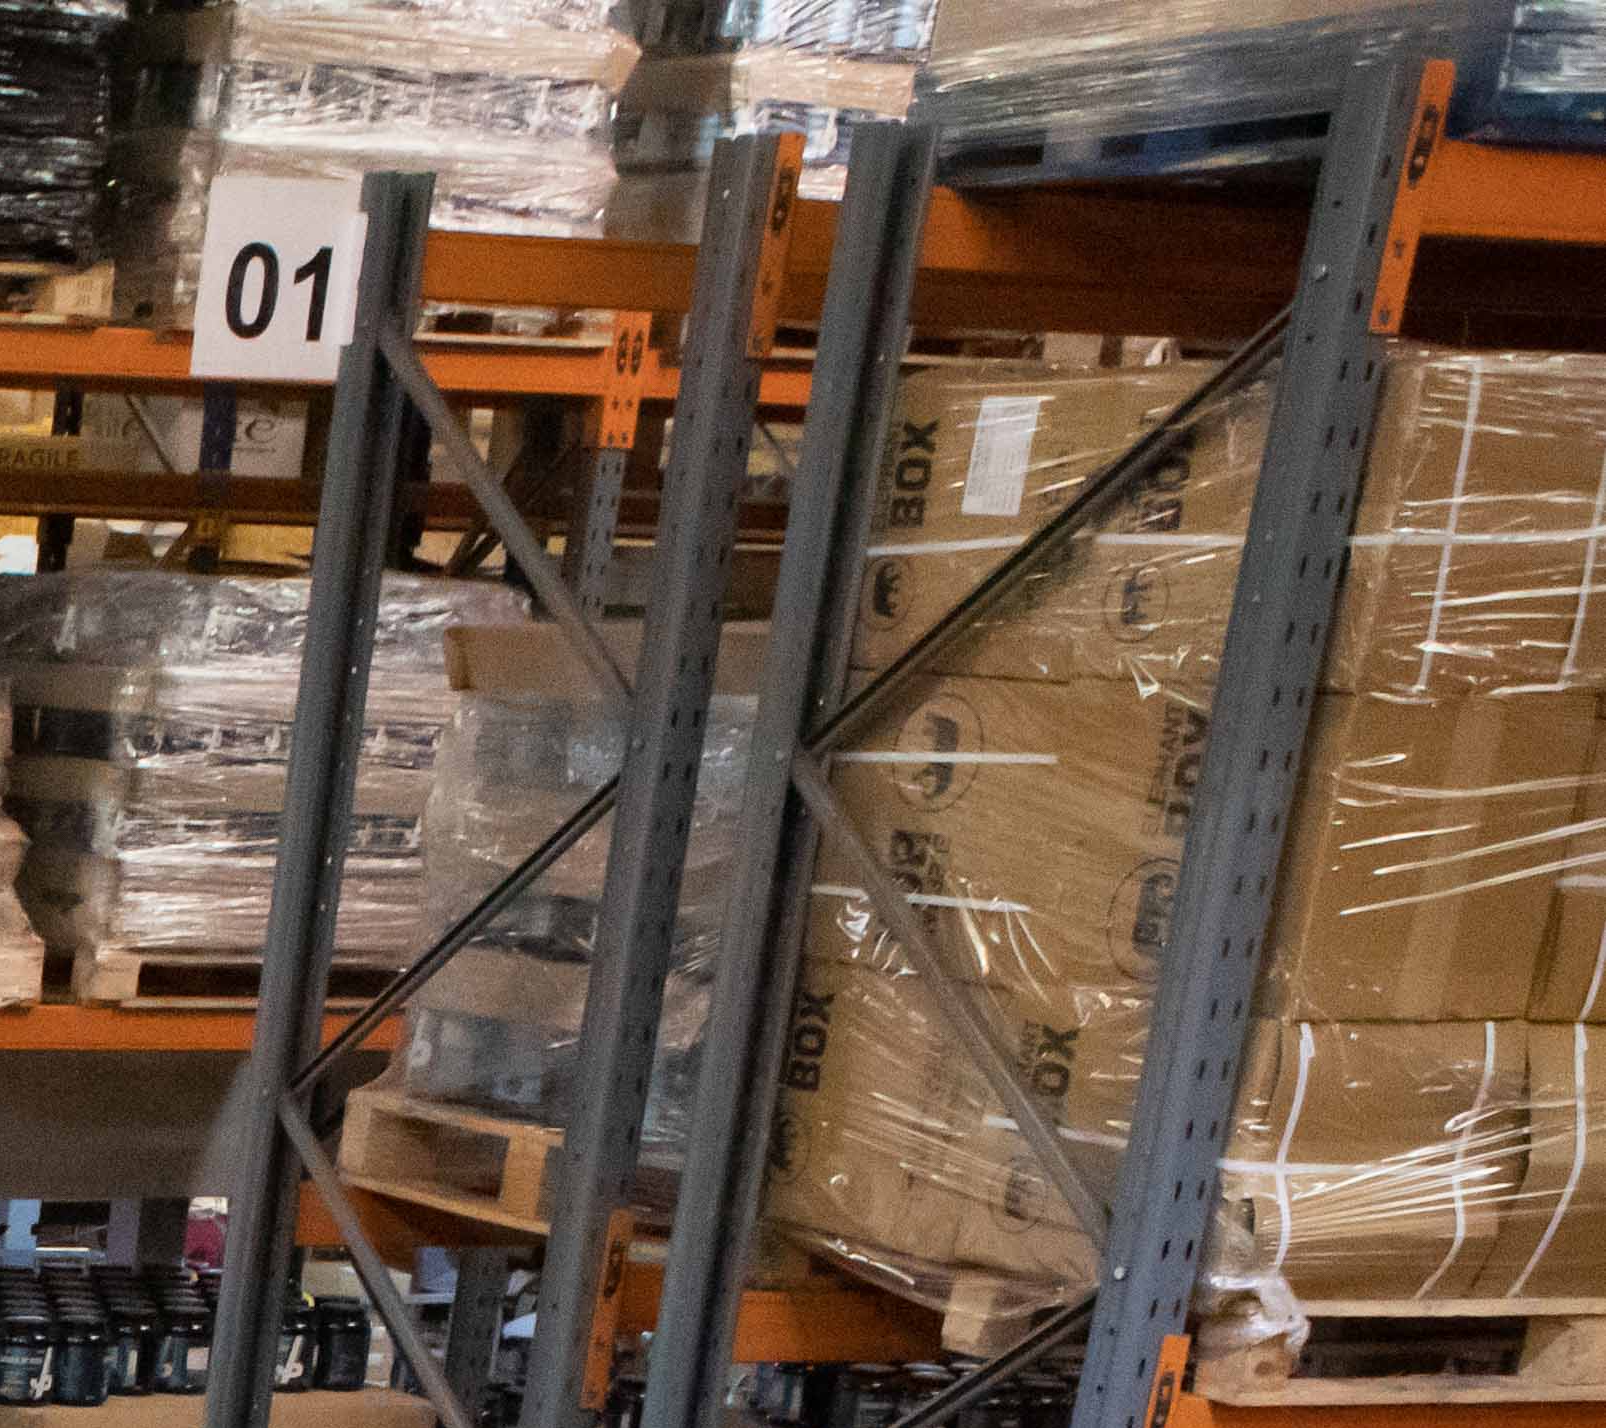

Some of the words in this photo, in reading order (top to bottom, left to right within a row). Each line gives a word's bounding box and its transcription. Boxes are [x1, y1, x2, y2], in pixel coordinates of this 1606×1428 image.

[223, 241, 334, 343] 01
[891, 417, 940, 528] BOX
[786, 994, 836, 1092] BOX
